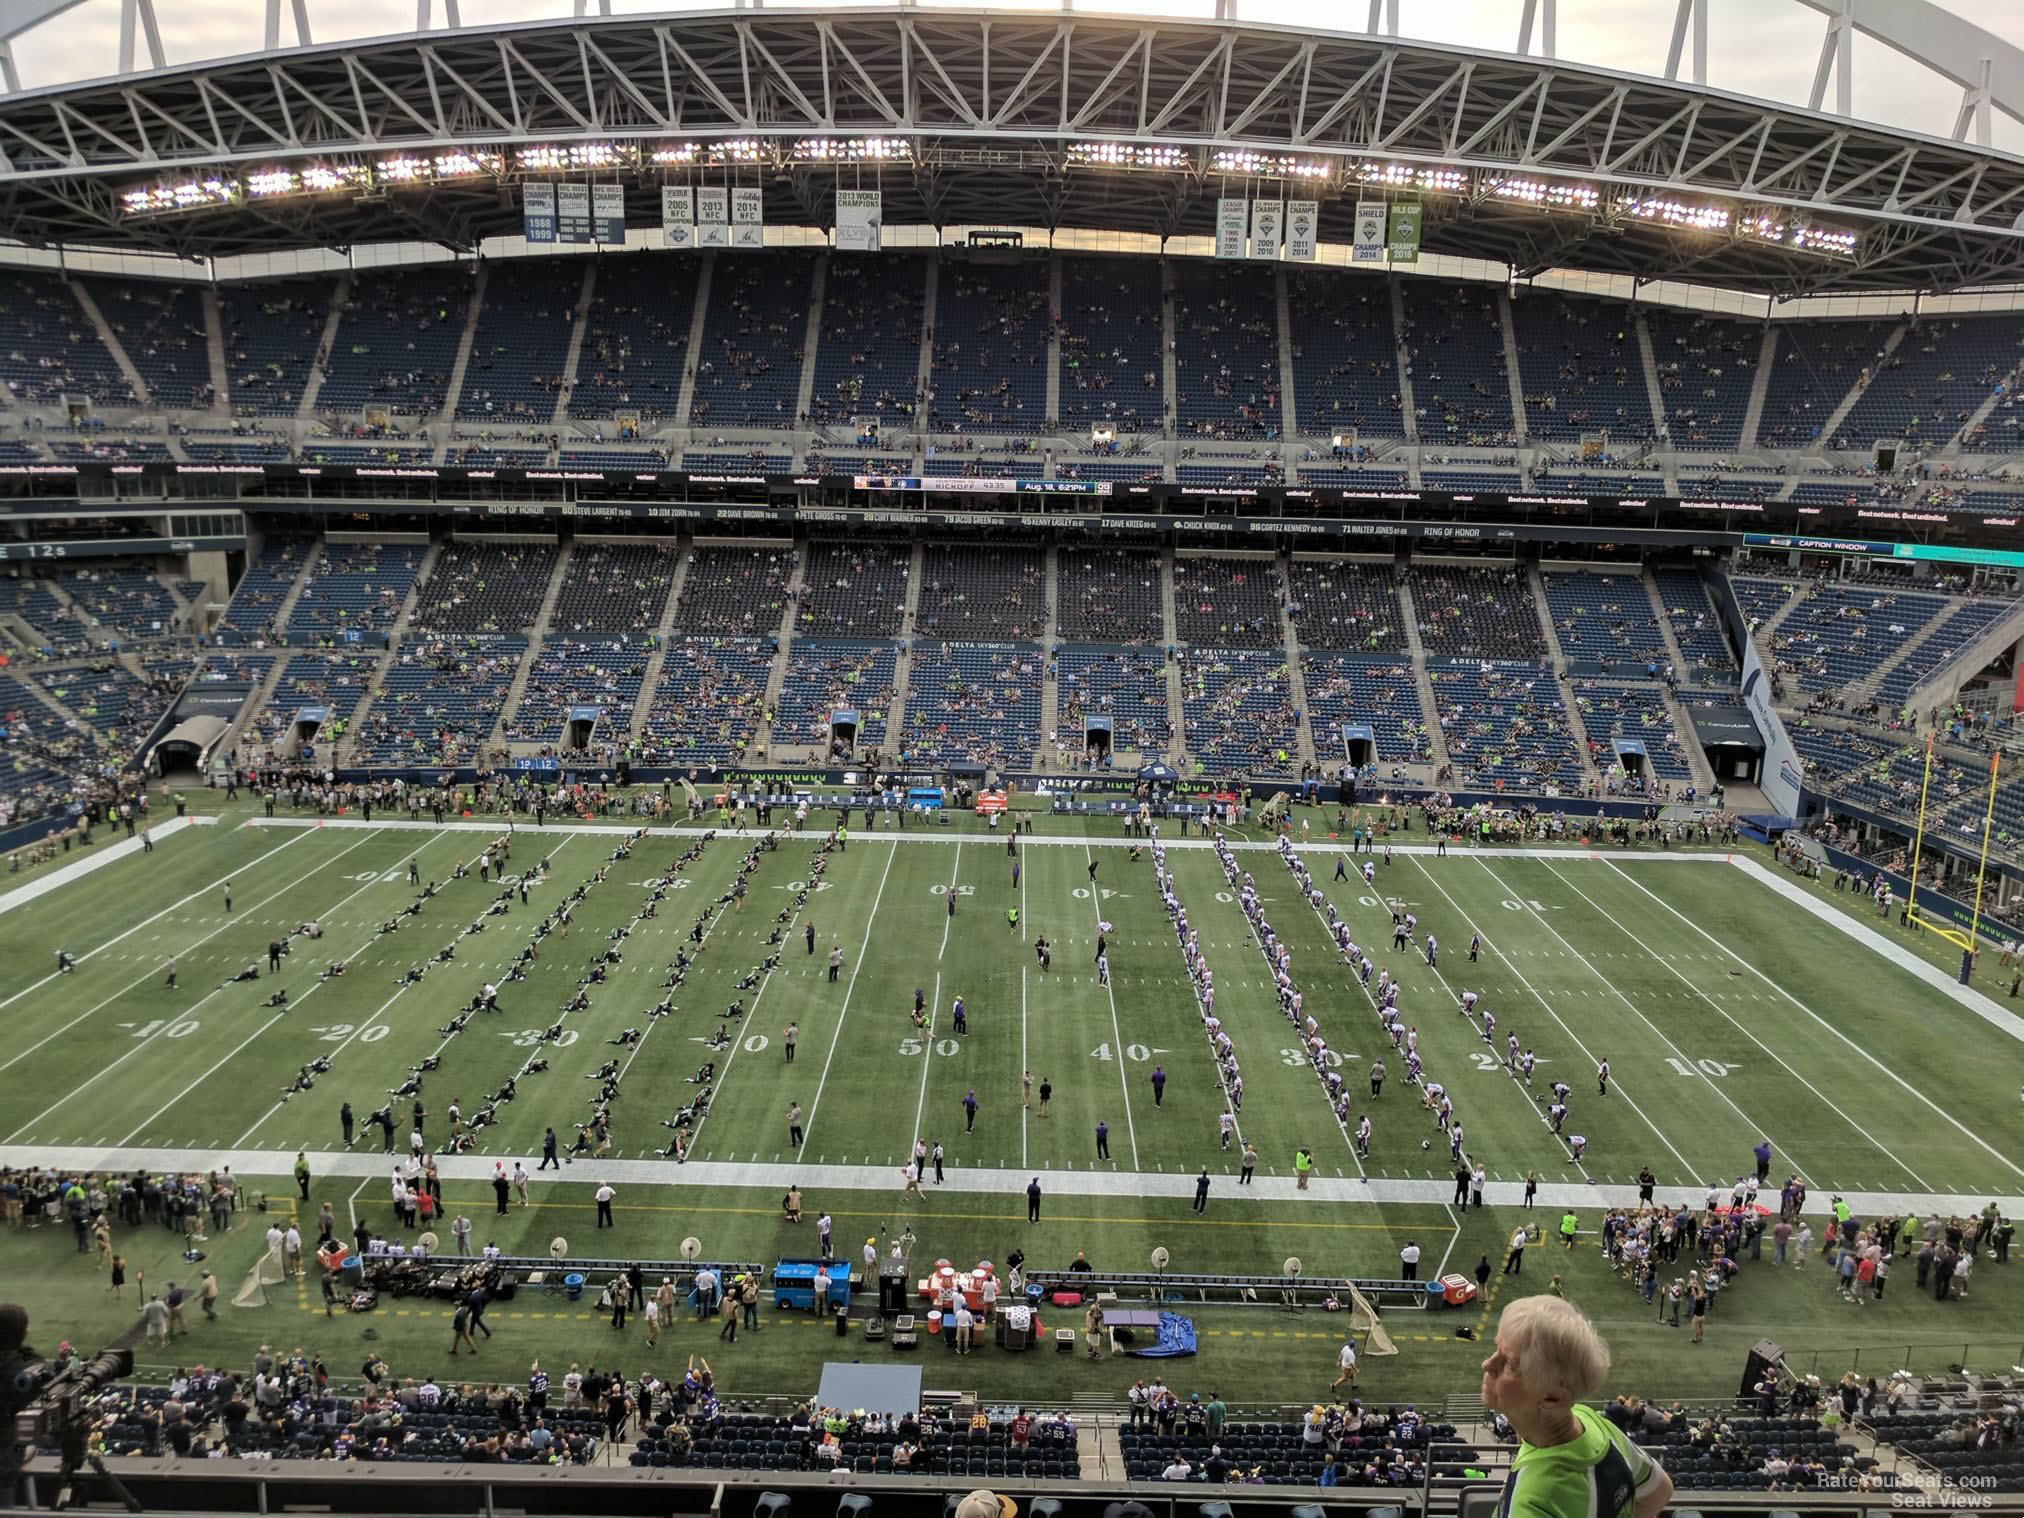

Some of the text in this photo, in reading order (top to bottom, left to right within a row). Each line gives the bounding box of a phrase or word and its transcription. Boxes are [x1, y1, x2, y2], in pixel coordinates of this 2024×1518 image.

[560, 192, 588, 200] CHAMPS
[594, 193, 622, 201] CHAMPS
[838, 192, 879, 201] 2013 WORLD
[668, 201, 688, 210] 2005
[702, 202, 723, 211] 2013
[737, 203, 758, 212] 2014
[838, 200, 879, 208] CHAMPIONS
[1358, 210, 1384, 218] SHIELD
[1392, 206, 1406, 214] MLS
[530, 219, 551, 228] 1988
[530, 230, 552, 239] 1999
[1391, 243, 1418, 251] CHAMPS
[1394, 251, 1412, 259] 2016
[1025, 483, 1043, 492] Aug.
[1045, 484, 1055, 492] 18,
[488, 506, 544, 515] RING OF HONOR
[574, 507, 591, 515] STEVE
[593, 508, 618, 516] LARGENT
[649, 508, 687, 517] 10 JIM ZORN
[717, 510, 765, 519] 22 DAVE BROWN
[800, 512, 814, 520] PETE
[875, 514, 914, 522] CURT WARNER
[955, 516, 972, 524] JACOB
[973, 516, 991, 524] GREEN
[1873, 511, 1901, 519] network.
[1902, 512, 1917, 520] Best
[1917, 513, 1948, 522] unlimited.
[1021, 517, 1072, 527] 45 KENNY EASLEY
[1110, 520, 1125, 528] DAVE
[1126, 520, 1143, 528] KRIEG
[1184, 522, 1220, 530] CHUCK KNOX
[1983, 518, 2015, 526] unlimited
[1250, 523, 1311, 532] 96 CORTEZ KENNEDY
[1343, 525, 1394, 535] 71 WALTER JONES
[1424, 528, 1480, 537] RING OF HONOR
[1799, 540, 1832, 548] CAPTION
[1834, 542, 1868, 551] WINDOW
[28, 545, 66, 558] 12s
[1708, 721, 1751, 729] CenturyLink
[541, 761, 552, 769] 12
[131, 1020, 200, 1038] 10
[319, 1024, 390, 1043] 20
[513, 1029, 579, 1047] 30
[898, 1039, 960, 1056] 50
[1090, 1043, 1151, 1061] 40
[1280, 1049, 1343, 1067] 30
[1665, 1058, 1728, 1077] 10
[535, 1381, 548, 1393] 22
[972, 1417, 986, 1428] 28
[1189, 1414, 1200, 1423] 22
[1016, 1424, 1026, 1433] 53
[1053, 1430, 1065, 1438] 55
